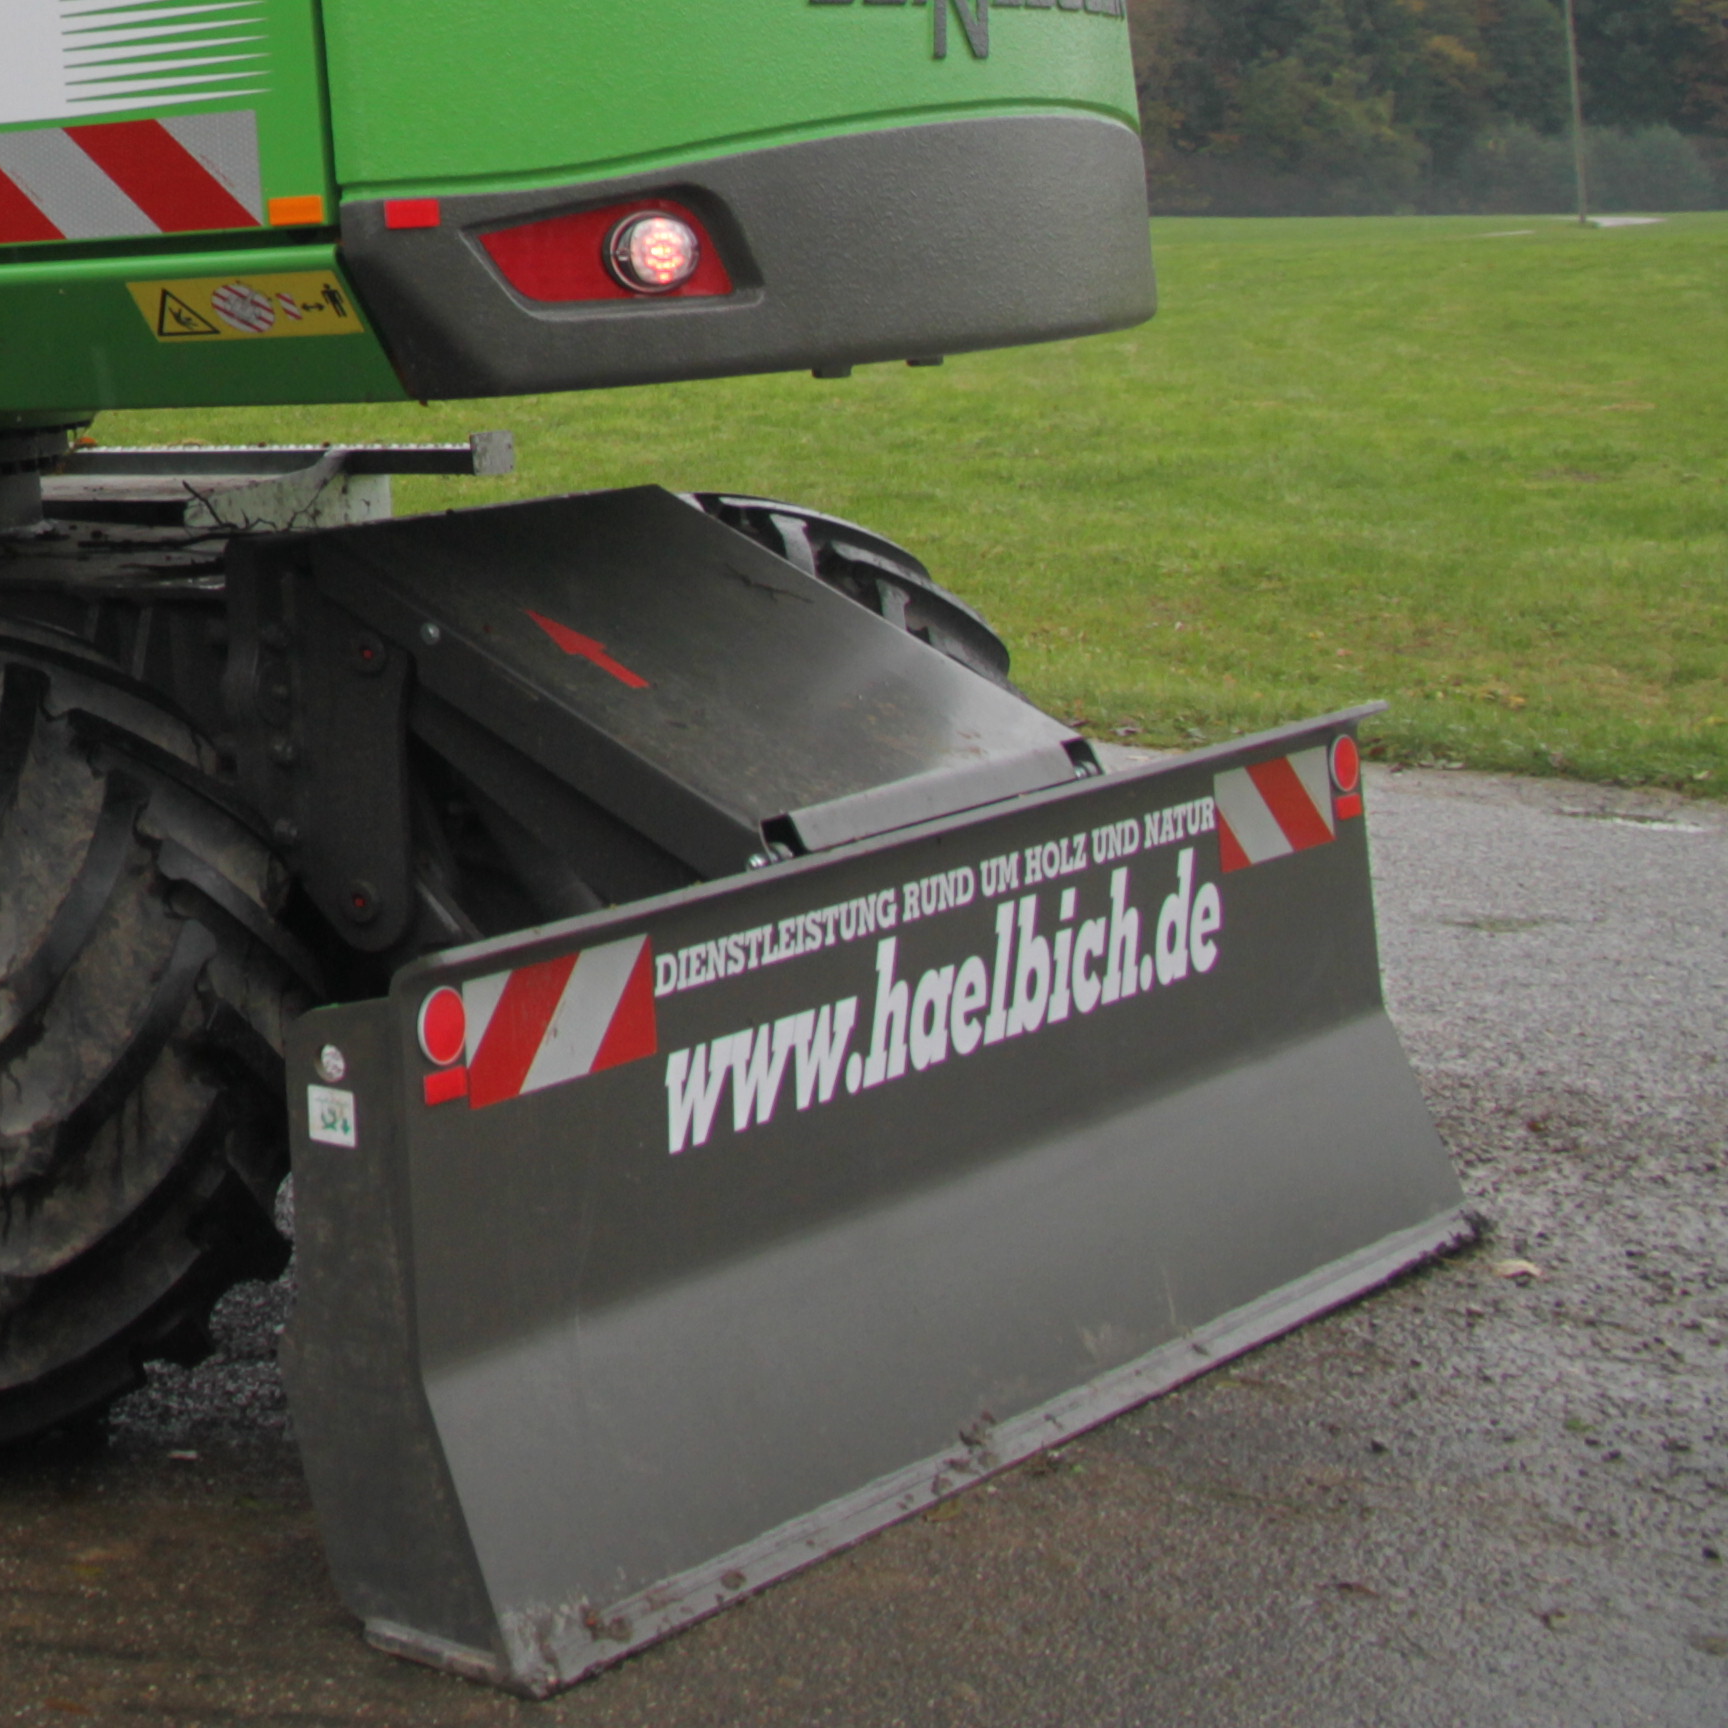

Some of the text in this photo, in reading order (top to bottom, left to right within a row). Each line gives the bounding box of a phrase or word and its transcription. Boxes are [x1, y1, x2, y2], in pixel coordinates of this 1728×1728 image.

[654, 796, 1216, 997] DIENSTLEISTUNG RUND UM HOLZ UND NATUR
[665, 847, 1222, 1155] www.haelbich.de
